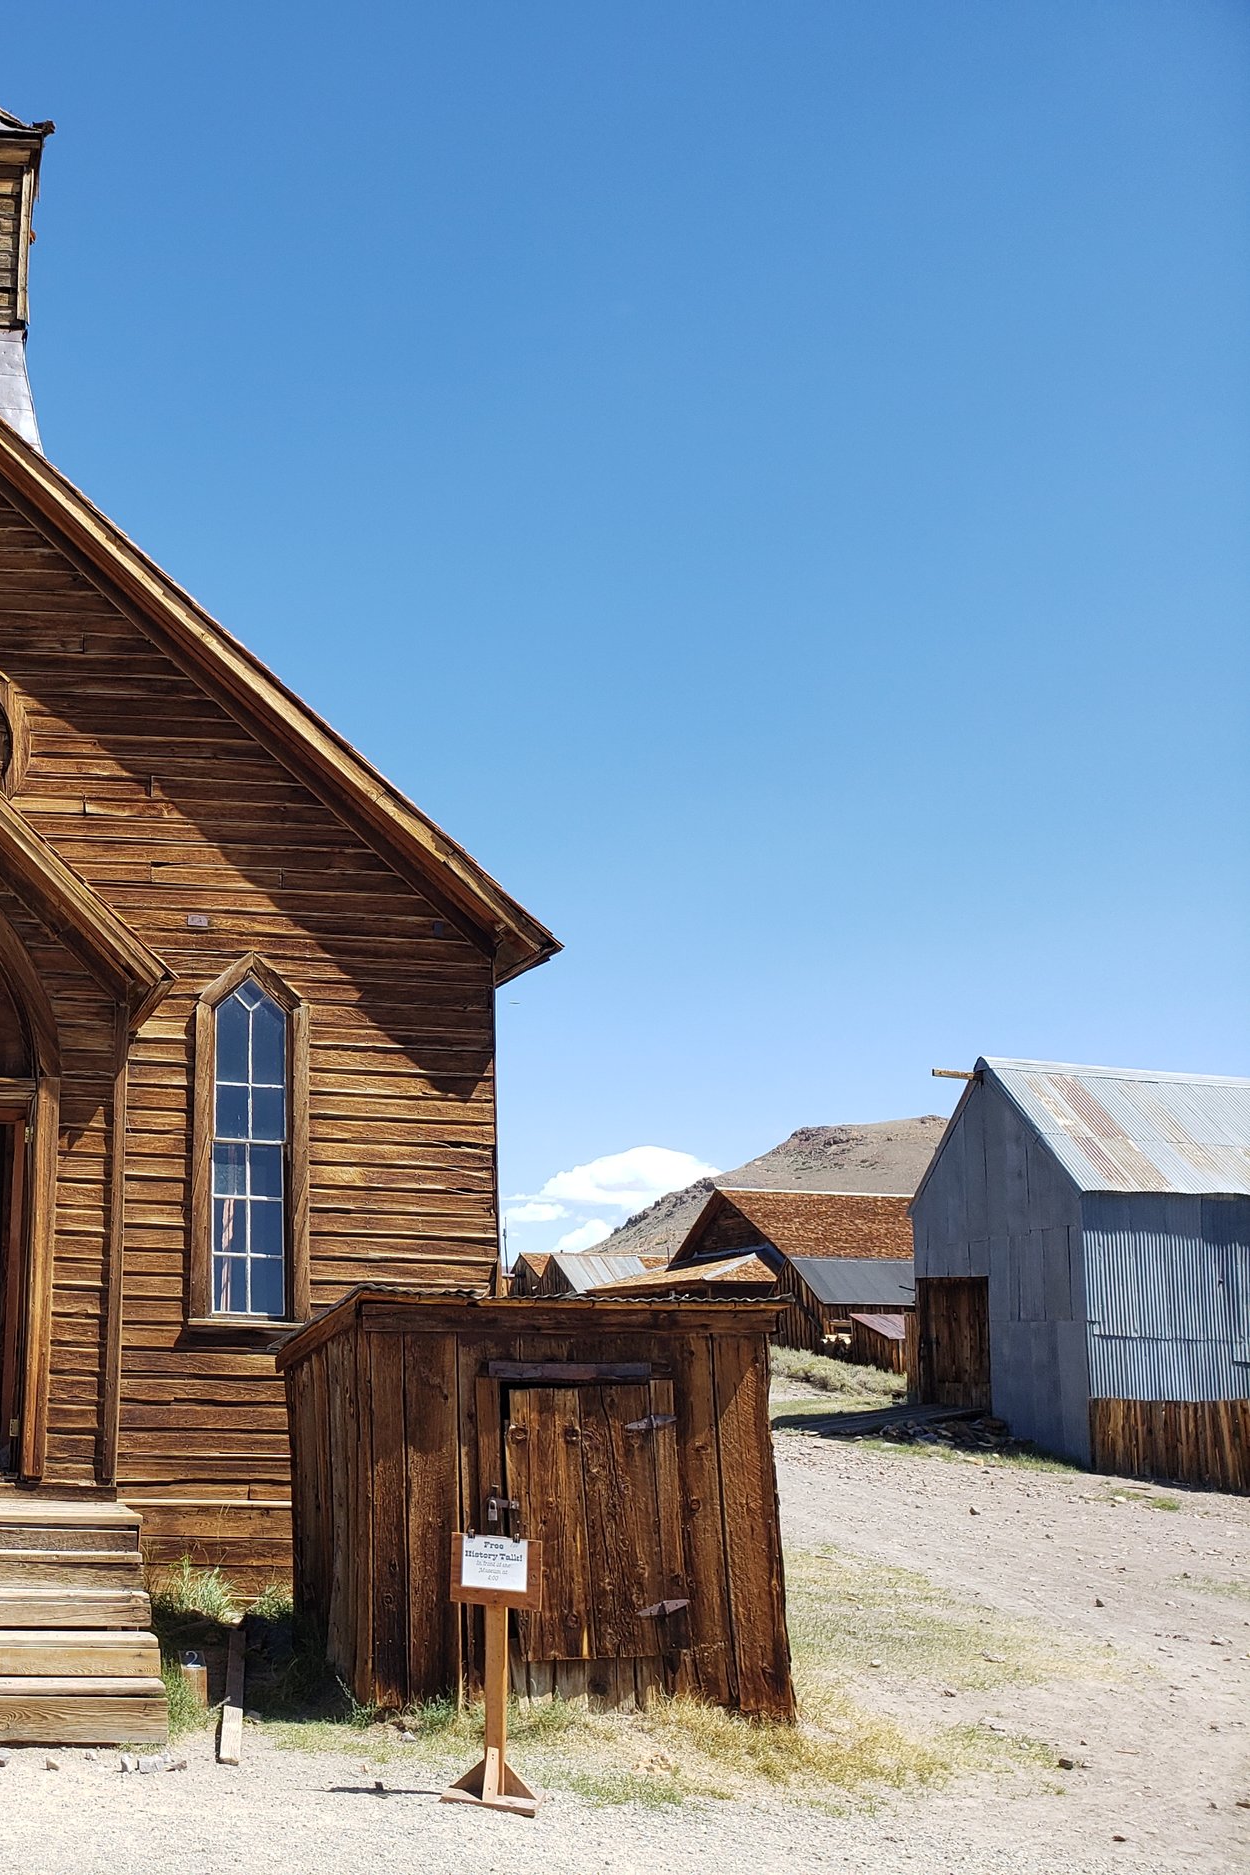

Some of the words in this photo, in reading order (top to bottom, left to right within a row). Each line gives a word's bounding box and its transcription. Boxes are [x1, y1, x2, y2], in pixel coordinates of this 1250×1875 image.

[484, 1541, 504, 1549] Free
[465, 1550, 498, 1561] History
[499, 1553, 523, 1562] Talk!
[185, 1650, 201, 1668] 2
